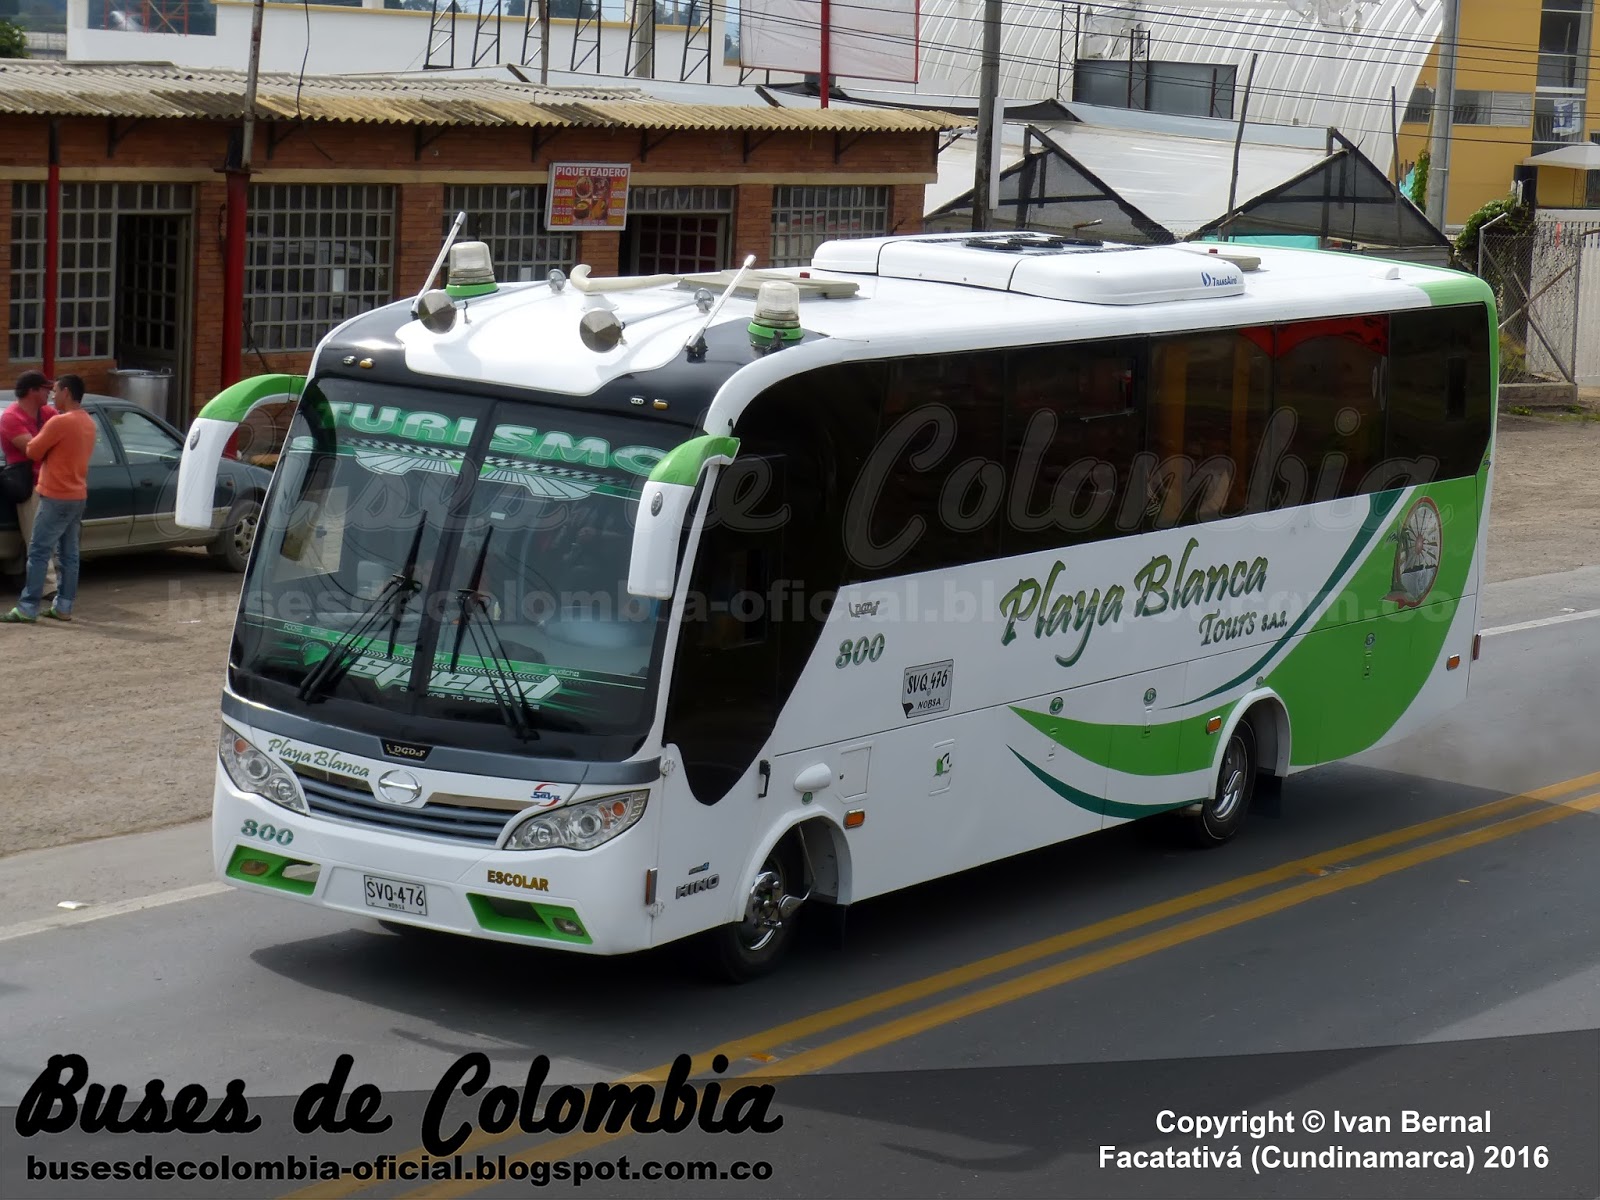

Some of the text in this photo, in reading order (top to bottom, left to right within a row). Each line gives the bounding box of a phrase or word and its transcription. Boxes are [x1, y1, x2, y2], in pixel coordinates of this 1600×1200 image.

[555, 166, 628, 177] PIQUETEADERO
[327, 400, 671, 477] TURISMO
[999, 537, 1269, 668] Playa Blanca
[1198, 608, 1258, 646] Tours
[835, 633, 885, 669] 800
[917, 698, 941, 709] NOBSA
[268, 736, 370, 778] Playa Blanca
[240, 818, 294, 846] 800
[487, 869, 549, 892] ESCOLAR
[675, 873, 720, 900] HINO
